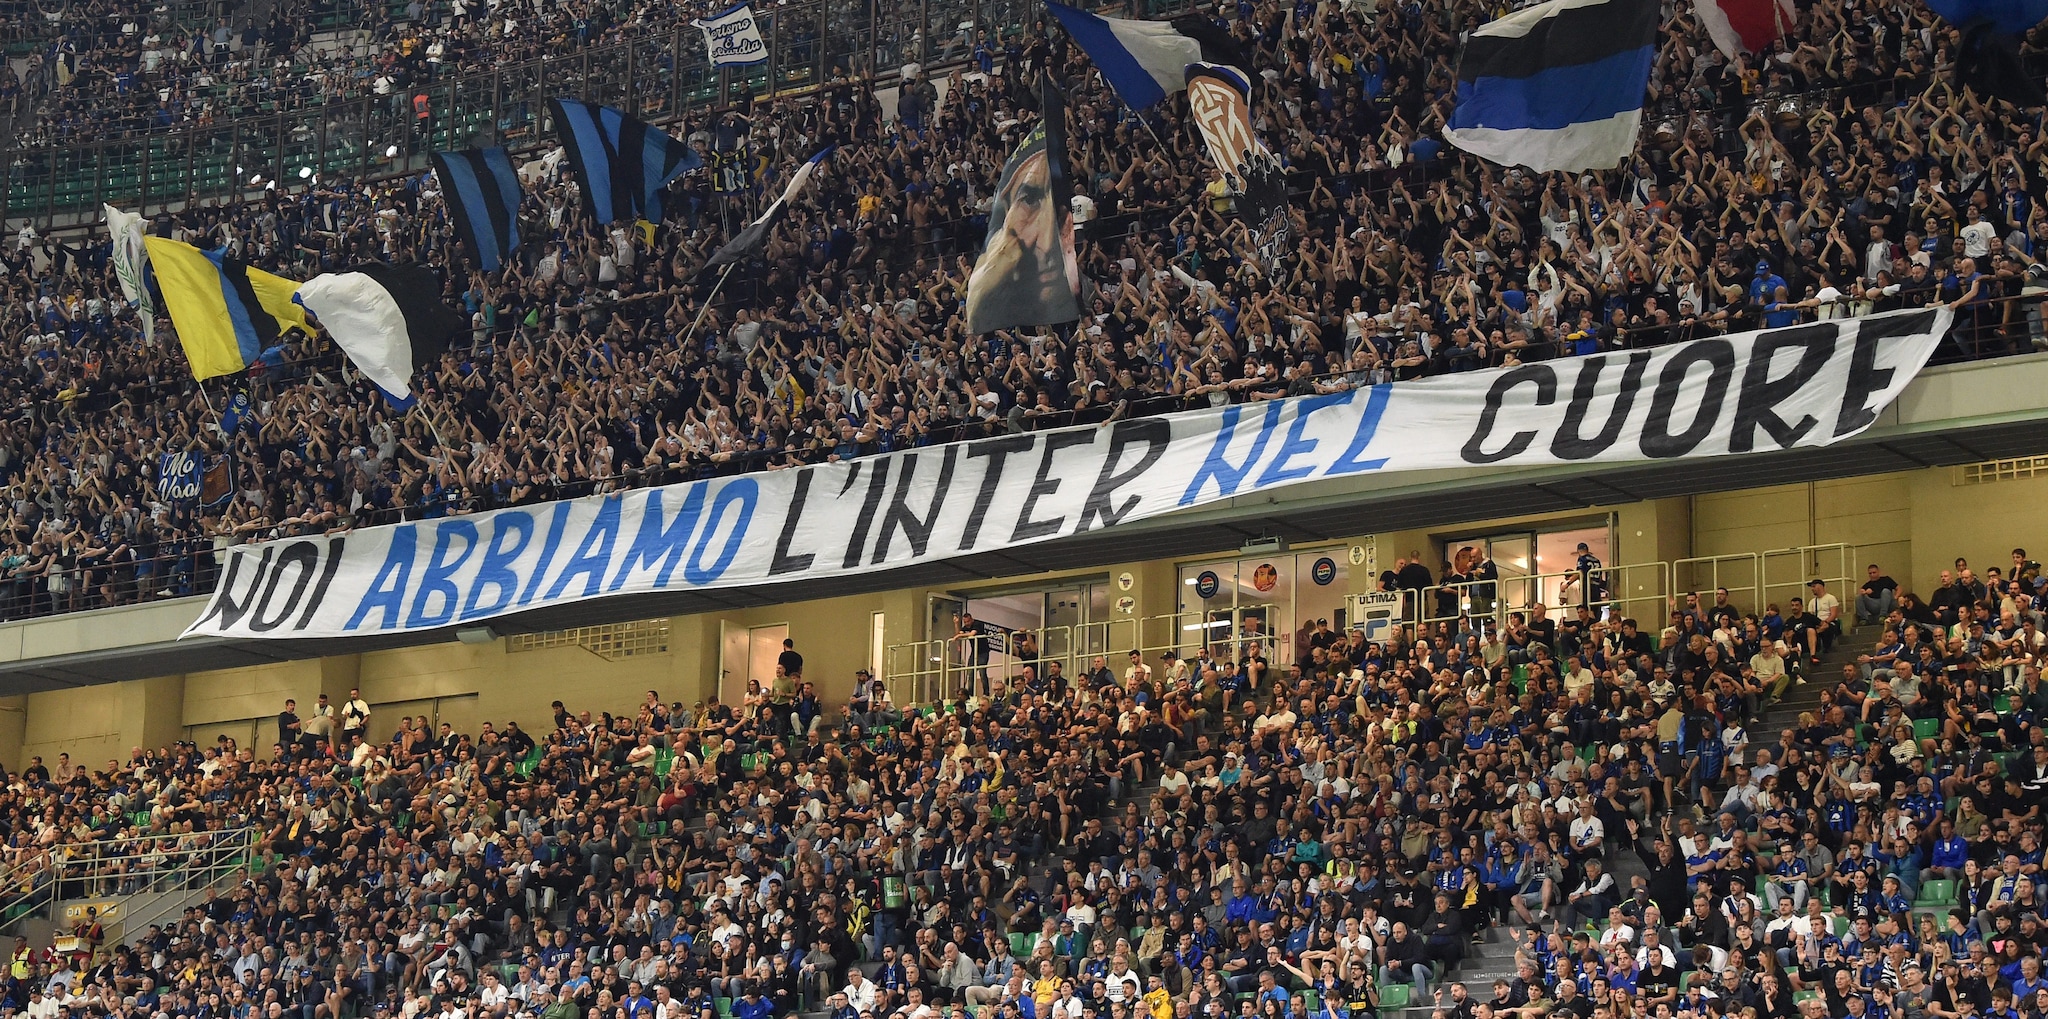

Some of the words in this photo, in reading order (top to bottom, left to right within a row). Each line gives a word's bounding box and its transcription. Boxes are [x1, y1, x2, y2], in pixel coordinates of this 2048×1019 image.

[197, 537, 344, 632] NOI
[343, 477, 759, 630] ABBIAMO
[767, 417, 1171, 577] L'INTER
[1178, 382, 1393, 506] NEL
[1460, 309, 1937, 463] CUORE
[1359, 593, 1397, 604] ULTIMA
